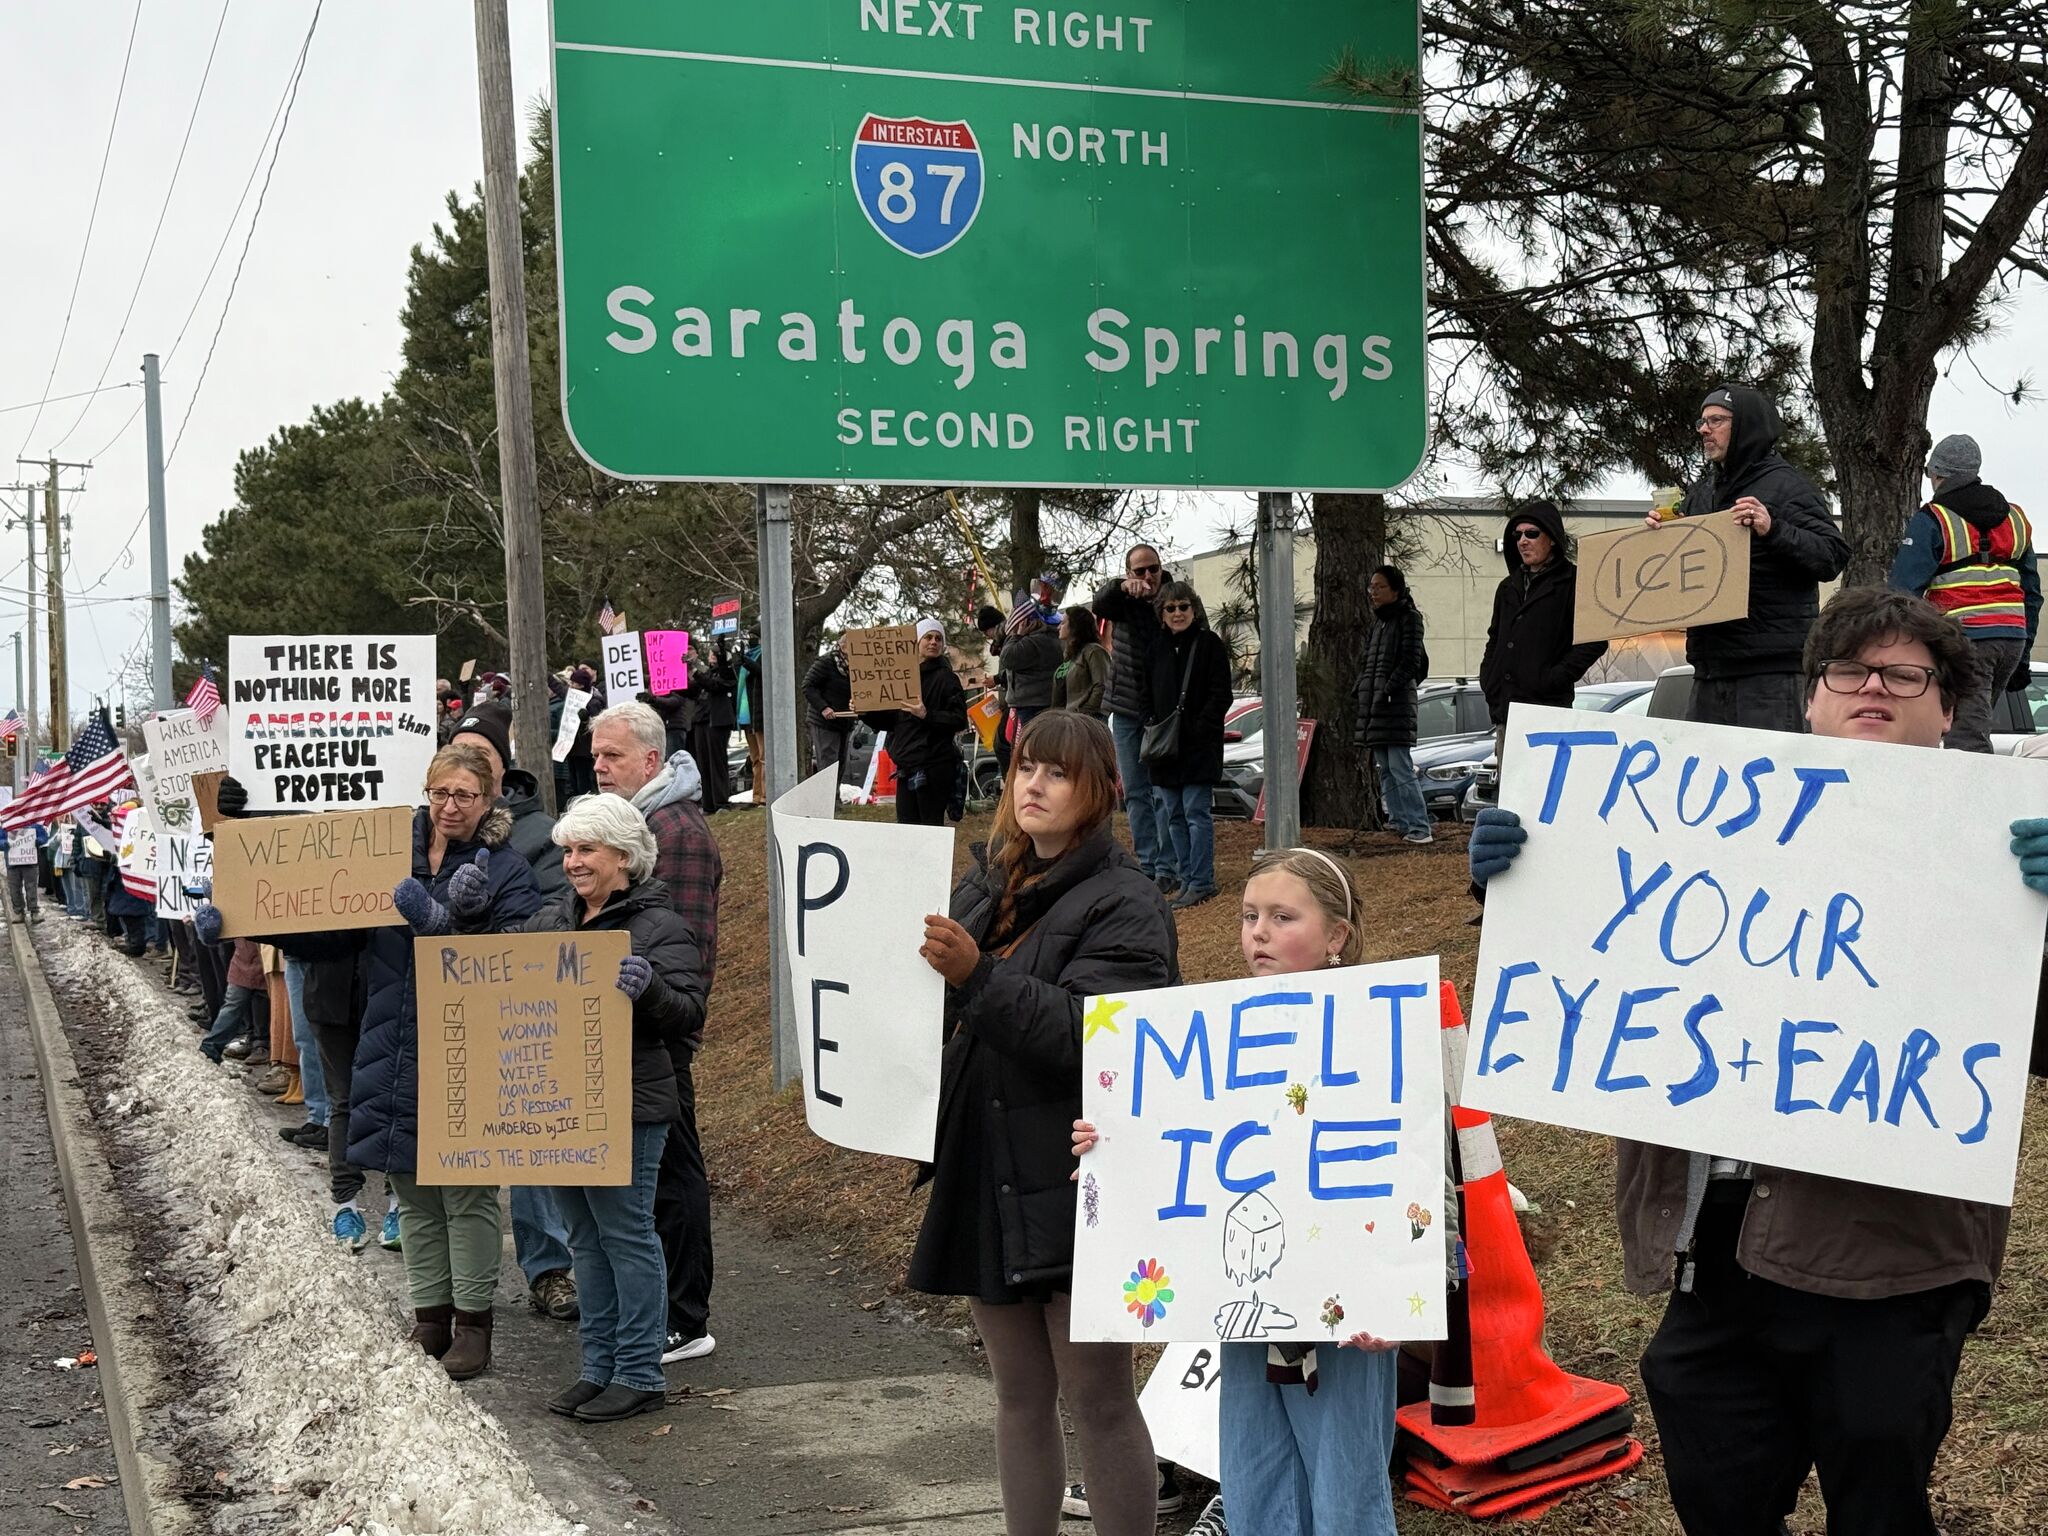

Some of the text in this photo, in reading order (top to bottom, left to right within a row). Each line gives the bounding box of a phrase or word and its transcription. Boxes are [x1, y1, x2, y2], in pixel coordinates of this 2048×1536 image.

[861, 0, 1153, 53] NEXT RIGHT
[872, 123, 961, 147] INTERSTATE
[1012, 123, 1169, 167] NORTH
[878, 162, 966, 225] 87
[605, 285, 1394, 401] Saratoga Springs
[837, 409, 1200, 455] SECOND RIGHT
[1614, 548, 1706, 599] ICE
[865, 628, 903, 640] WITH
[264, 643, 398, 671] THERE IS
[608, 643, 638, 664] DE-
[850, 640, 917, 656] LIBERTY
[656, 666, 667, 678] OF
[873, 656, 896, 668] AND
[234, 676, 411, 703] NOTHING MORE
[611, 669, 639, 690] ICE
[652, 677, 678, 691] EOPLE
[851, 669, 912, 683] JUSTICE
[853, 682, 919, 703] FOR ALL
[160, 719, 195, 742] WAKE
[244, 711, 394, 740] AMERICAN
[398, 712, 431, 737] than
[164, 738, 221, 768] AMERICA
[254, 739, 377, 770] PEACEFUL
[160, 772, 192, 796] STOP
[274, 769, 384, 803] PROTEST
[1526, 731, 1850, 846] TRUST
[238, 813, 403, 867] WE ARE ALL
[255, 868, 394, 921] RENEE GOOD
[1591, 846, 1879, 988] YOUR
[441, 941, 595, 986] RENEE ME
[499, 996, 558, 1019] HUMAN
[498, 1021, 558, 1041] WOMAN
[498, 1041, 553, 1065] WHITE
[1131, 982, 1428, 1118] MELT
[498, 1064, 547, 1081] WIFE
[498, 1082, 530, 1099] MOM
[549, 1079, 559, 1095] 3
[498, 1097, 574, 1117] US RESIDENT
[482, 1116, 580, 1140] MURDERED by ICE
[438, 1143, 609, 1171] WHAT'S THE DIFFERENCE?
[1158, 1118, 1401, 1221] ICE
